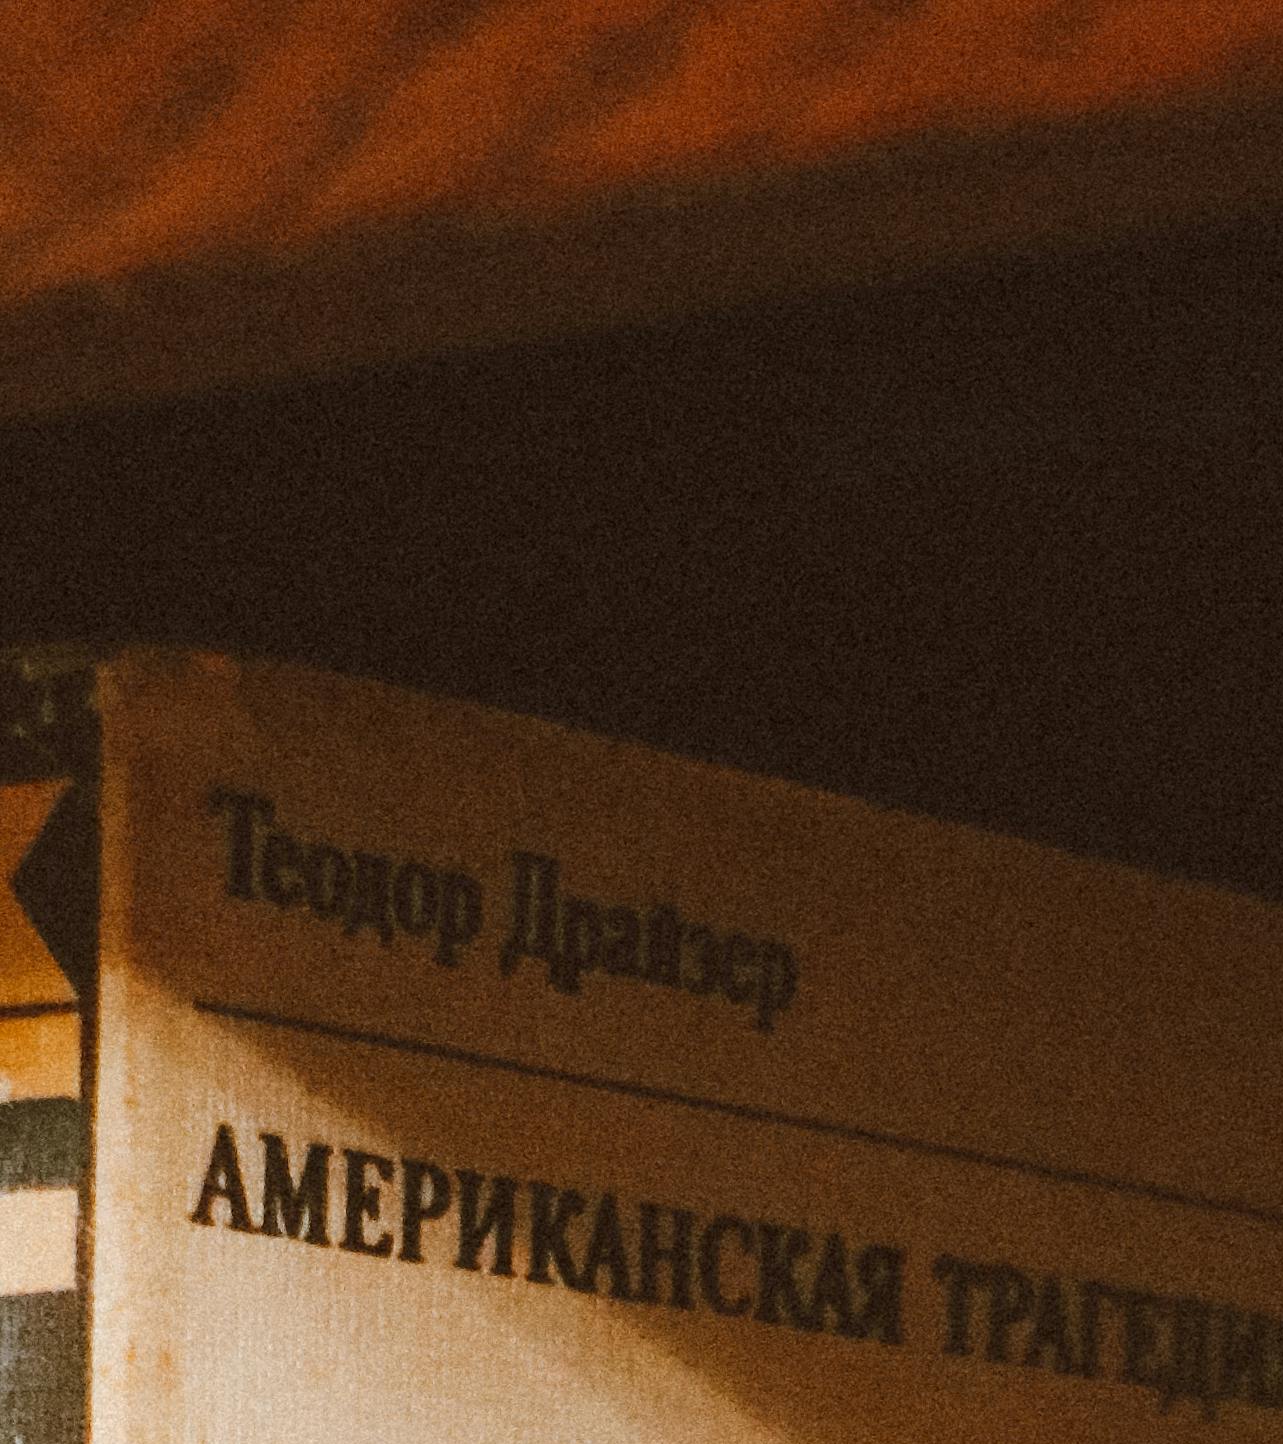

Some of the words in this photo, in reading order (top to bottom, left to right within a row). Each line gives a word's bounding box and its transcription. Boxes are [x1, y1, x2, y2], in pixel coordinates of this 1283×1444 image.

[207, 784, 484, 968] Теодор
[498, 850, 798, 1033] Драйзер
[191, 1121, 903, 1346] АМЕРИКАНСКАЯ
